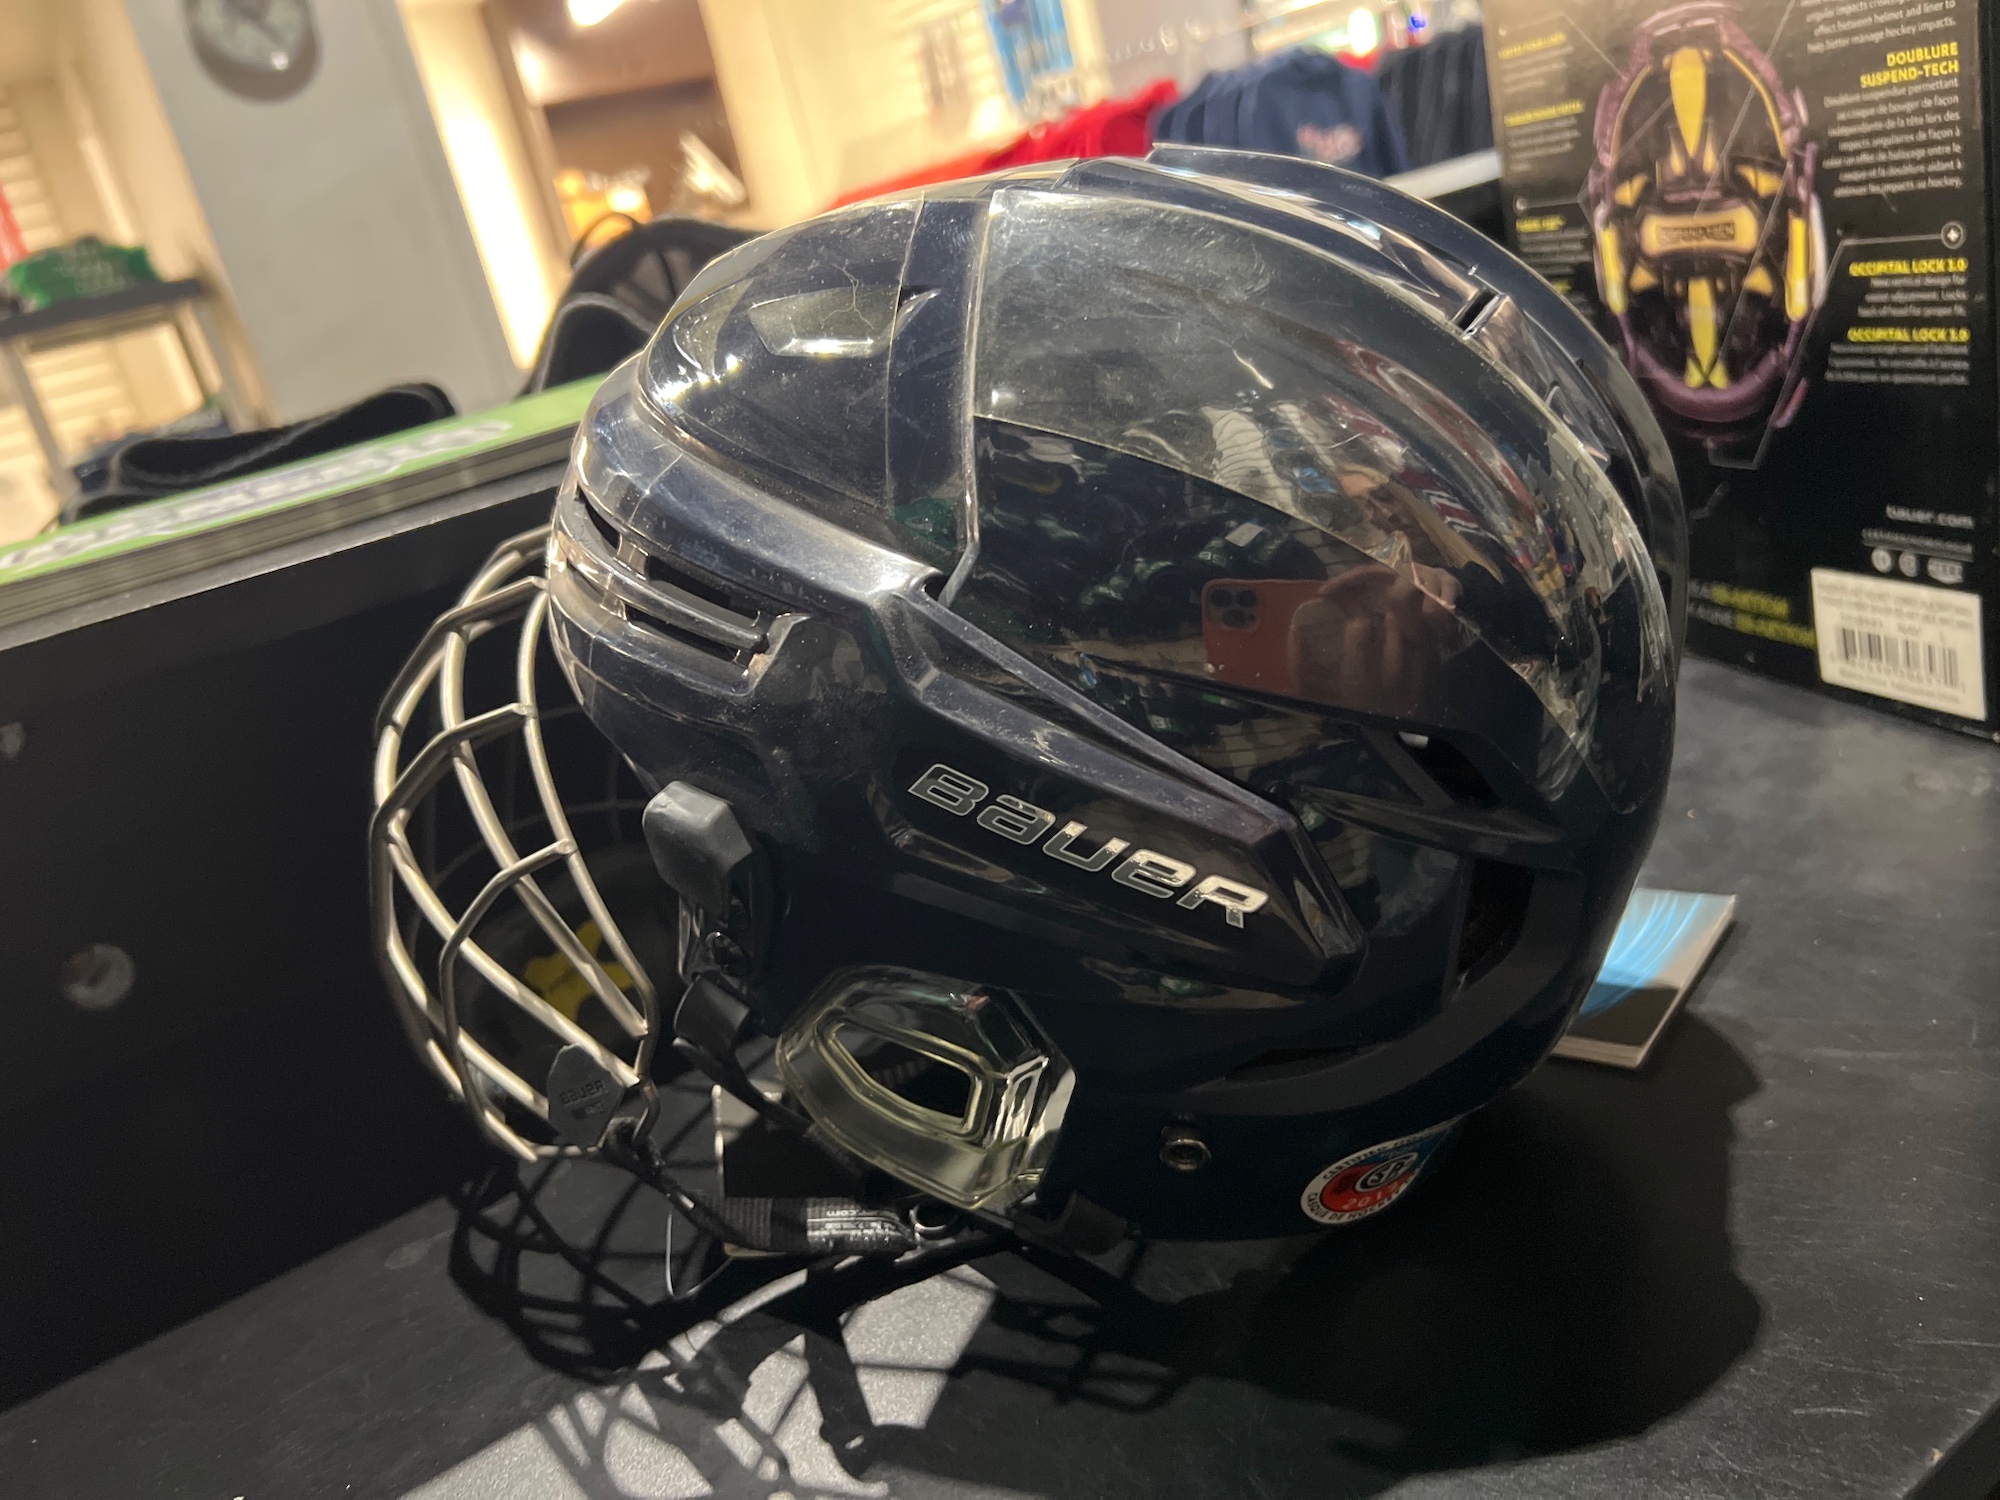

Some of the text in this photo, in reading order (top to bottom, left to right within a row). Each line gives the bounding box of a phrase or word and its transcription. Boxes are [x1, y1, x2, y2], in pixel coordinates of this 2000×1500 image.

[1874, 9, 1904, 24] helmet
[1905, 4, 1922, 18] and
[1923, 0, 1943, 14] liner
[1945, 0, 1957, 9] to
[1885, 24, 1917, 38] hockey
[1918, 15, 1957, 32] impacts.
[1886, 41, 1960, 68] DOUBLURE
[1860, 59, 1960, 89] SUSPEND-TECH
[1908, 77, 1959, 96] permettant
[1921, 97, 1933, 108] de
[1933, 94, 1960, 108] façon
[1925, 111, 1942, 124] lors
[1943, 110, 1960, 122] des
[1915, 129, 1927, 142] de
[1928, 126, 1953, 141] façon
[1951, 141, 1962, 154] le
[1911, 258, 1946, 275] LOCK
[1911, 326, 1947, 343] LOCK
